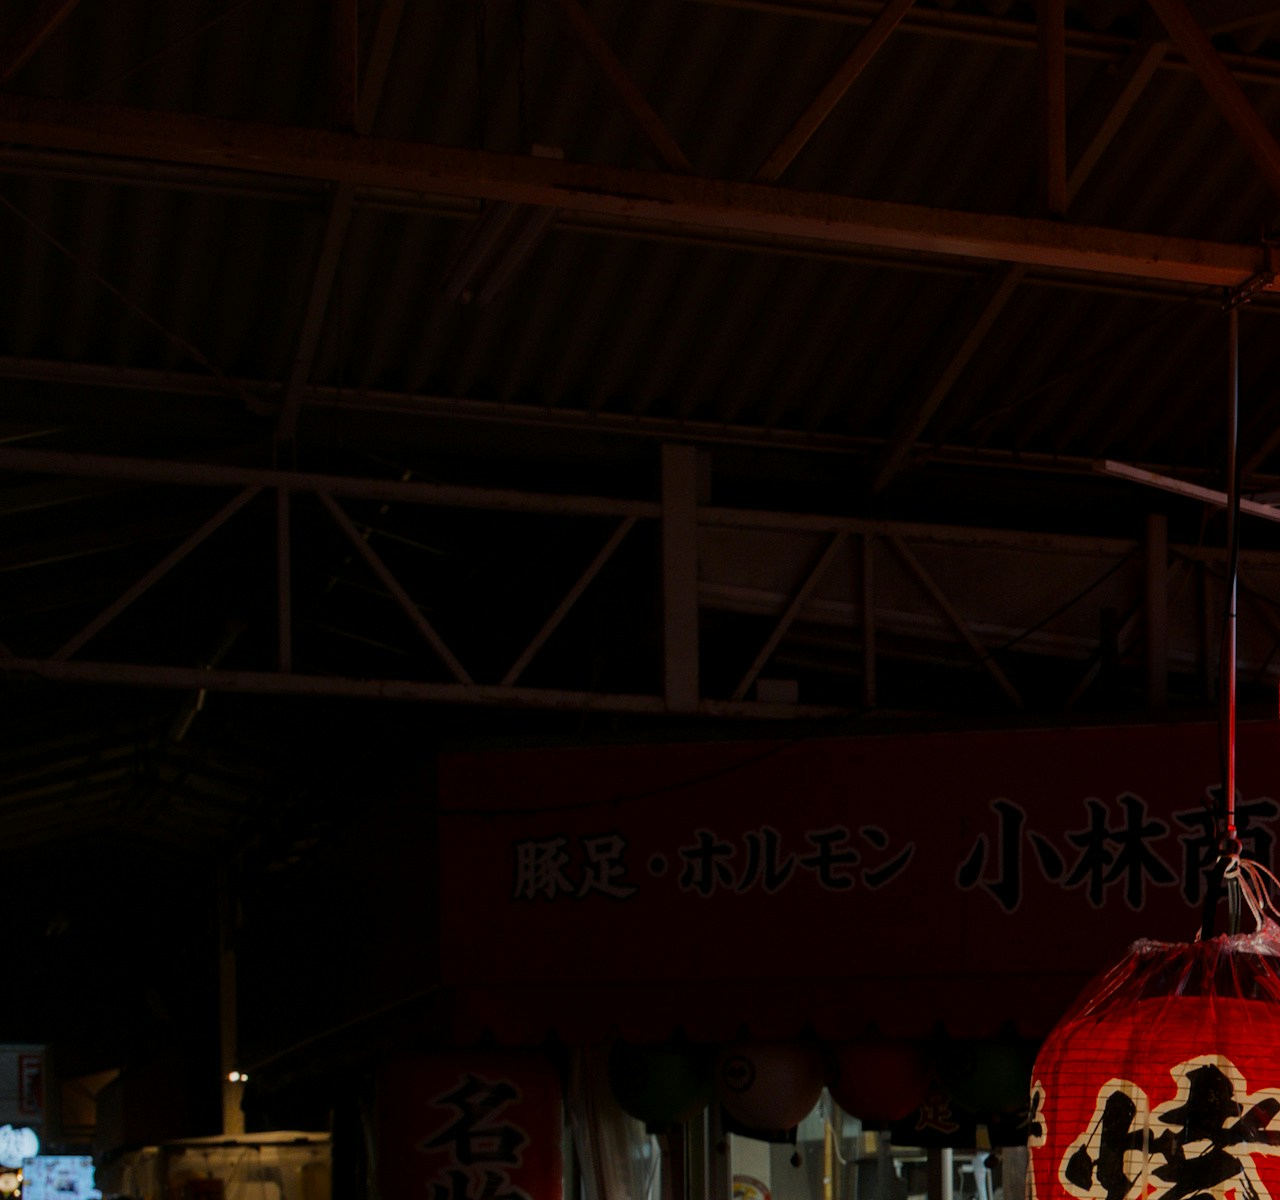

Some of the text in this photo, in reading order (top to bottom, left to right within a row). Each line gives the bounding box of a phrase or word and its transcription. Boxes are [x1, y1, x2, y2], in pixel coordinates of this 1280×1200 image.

[511, 826, 915, 902] 豚足・ホルモン
